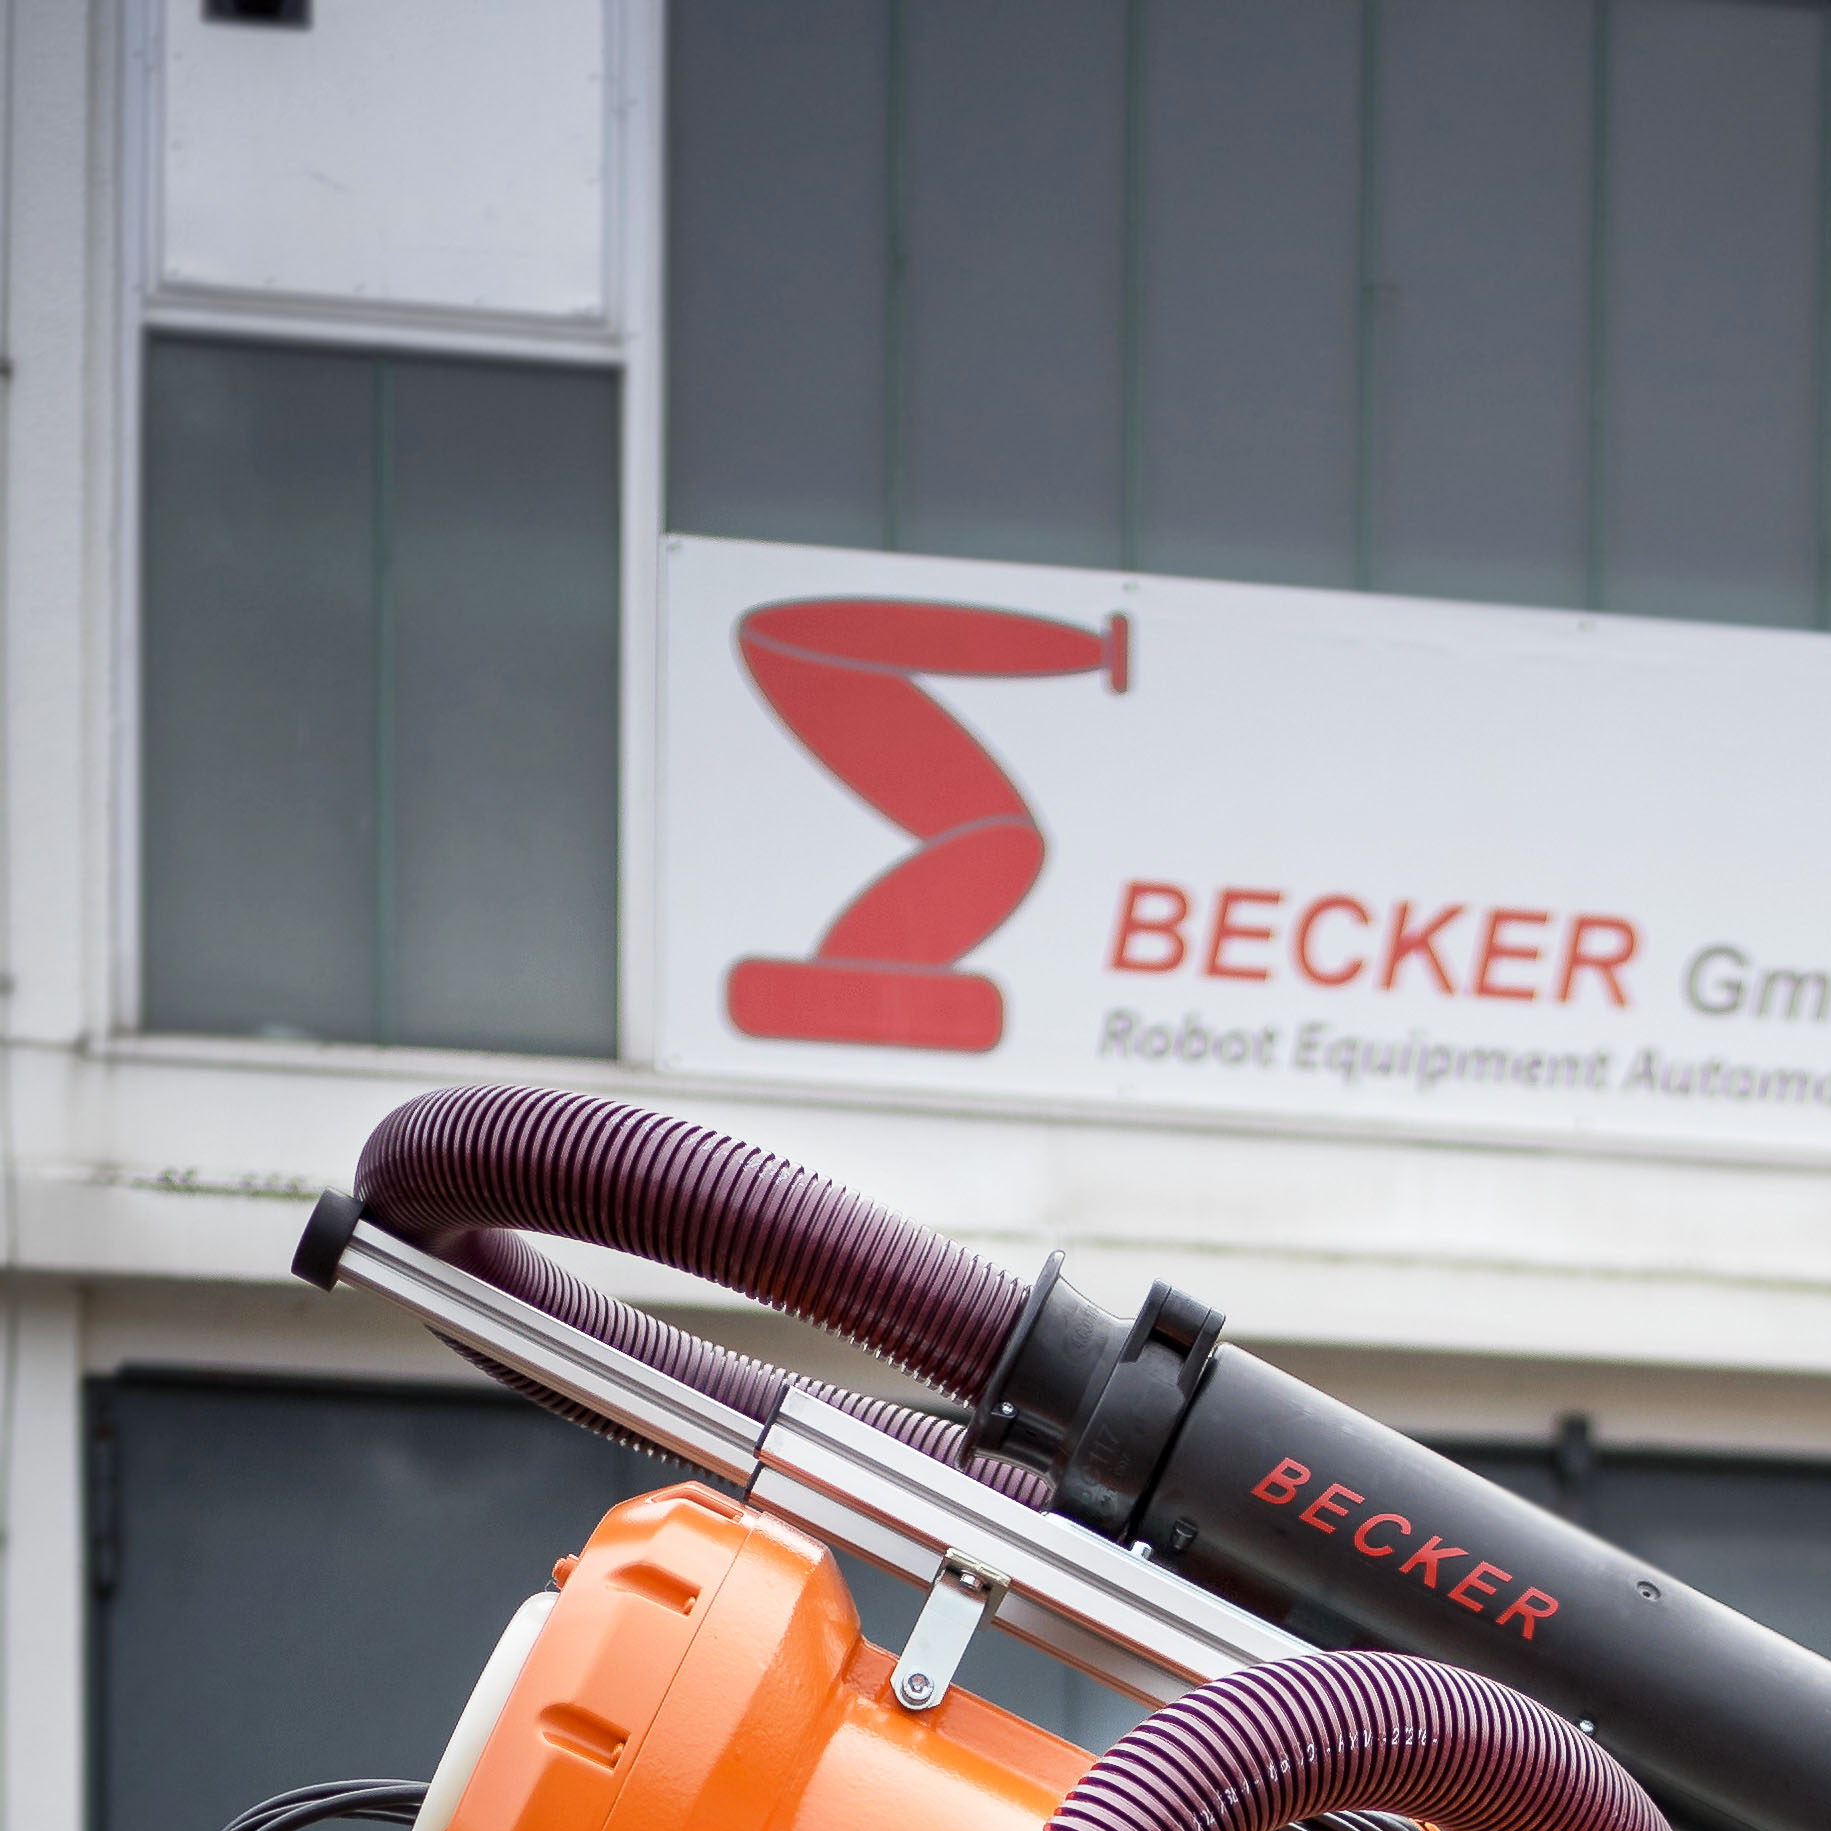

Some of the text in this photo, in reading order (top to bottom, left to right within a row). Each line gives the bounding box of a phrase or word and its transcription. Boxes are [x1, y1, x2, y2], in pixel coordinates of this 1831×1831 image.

[1104, 879, 1640, 1005] BECKER
[1100, 1007, 1279, 1070] Robot
[1292, 1023, 1607, 1094] Equipment
[1251, 1457, 1560, 1641] BECKER
